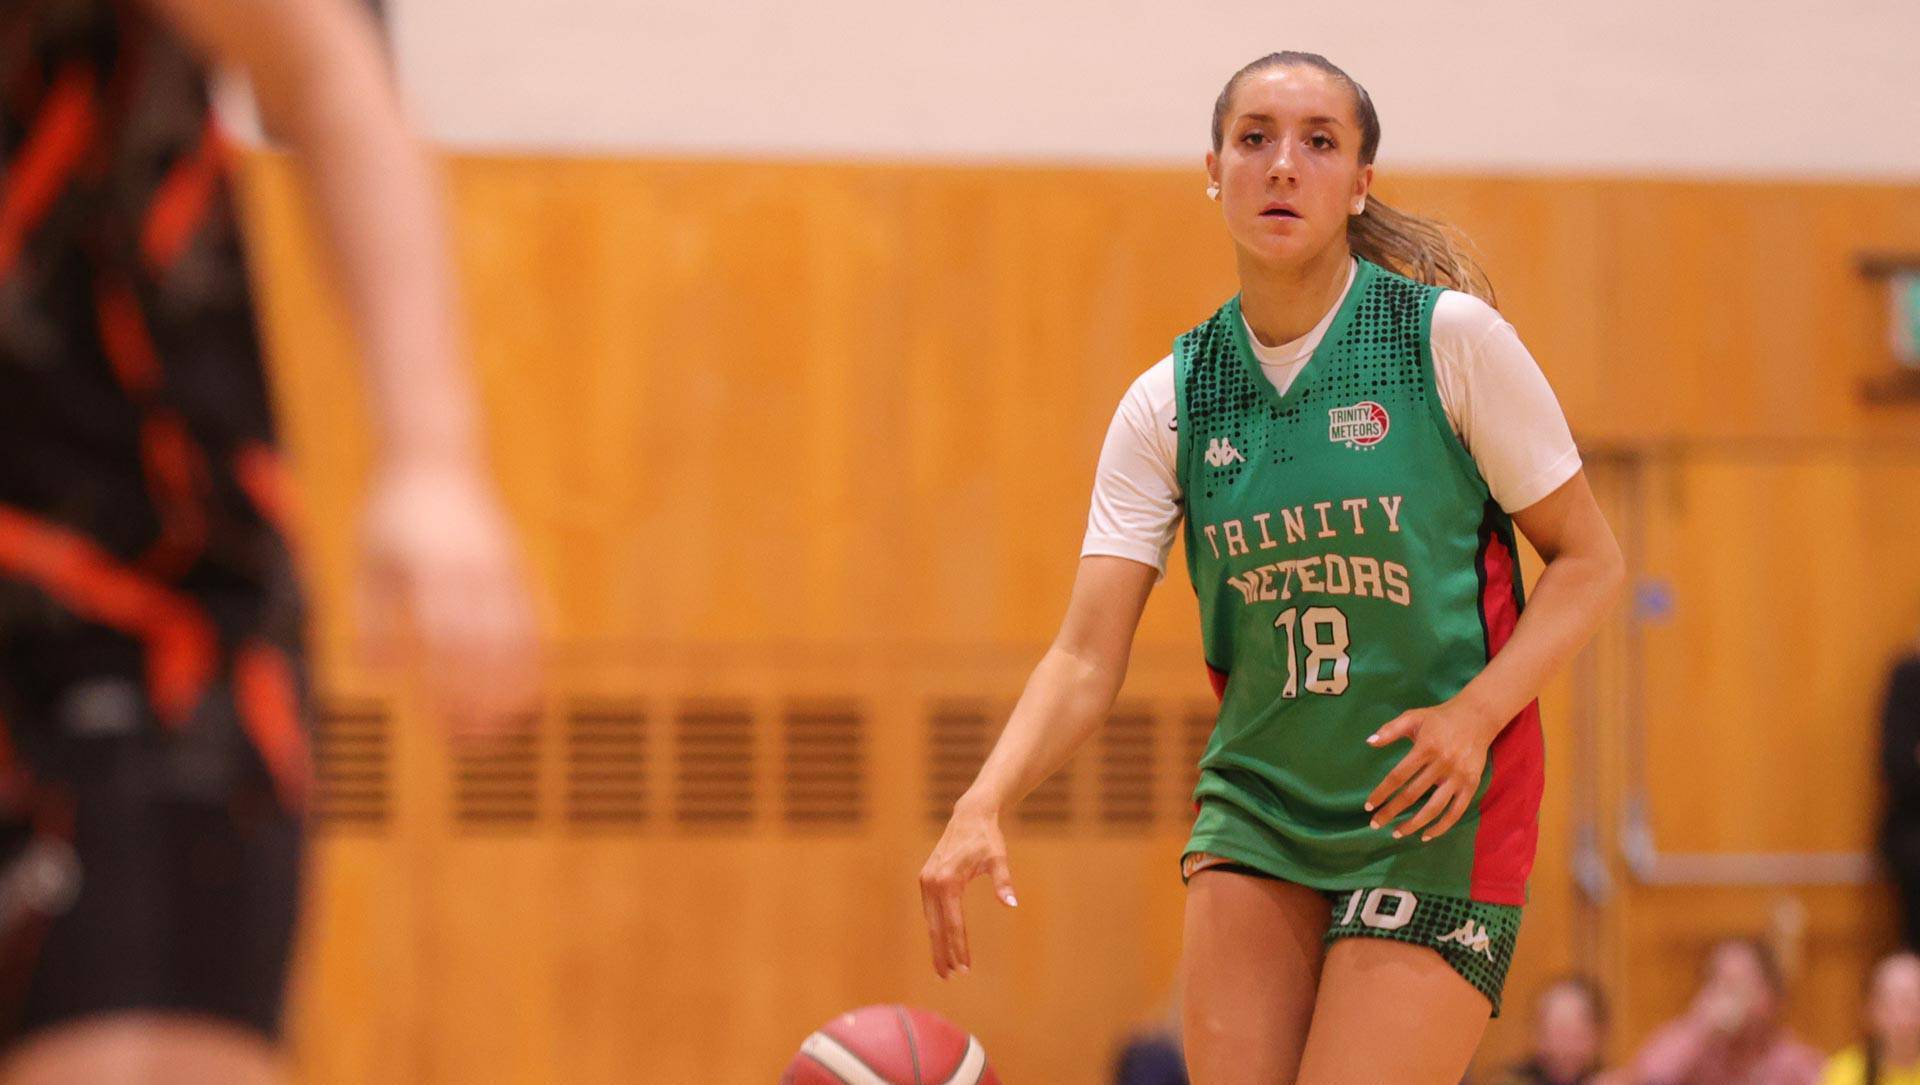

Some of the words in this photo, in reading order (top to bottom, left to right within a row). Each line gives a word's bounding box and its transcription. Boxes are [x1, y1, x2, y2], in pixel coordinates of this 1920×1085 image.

[1331, 407, 1370, 424] TRINITY
[1331, 422, 1380, 439] METEORS
[1203, 496, 1402, 560] TRINITY
[1226, 553, 1411, 607] METEORS
[1273, 606, 1351, 699] 18
